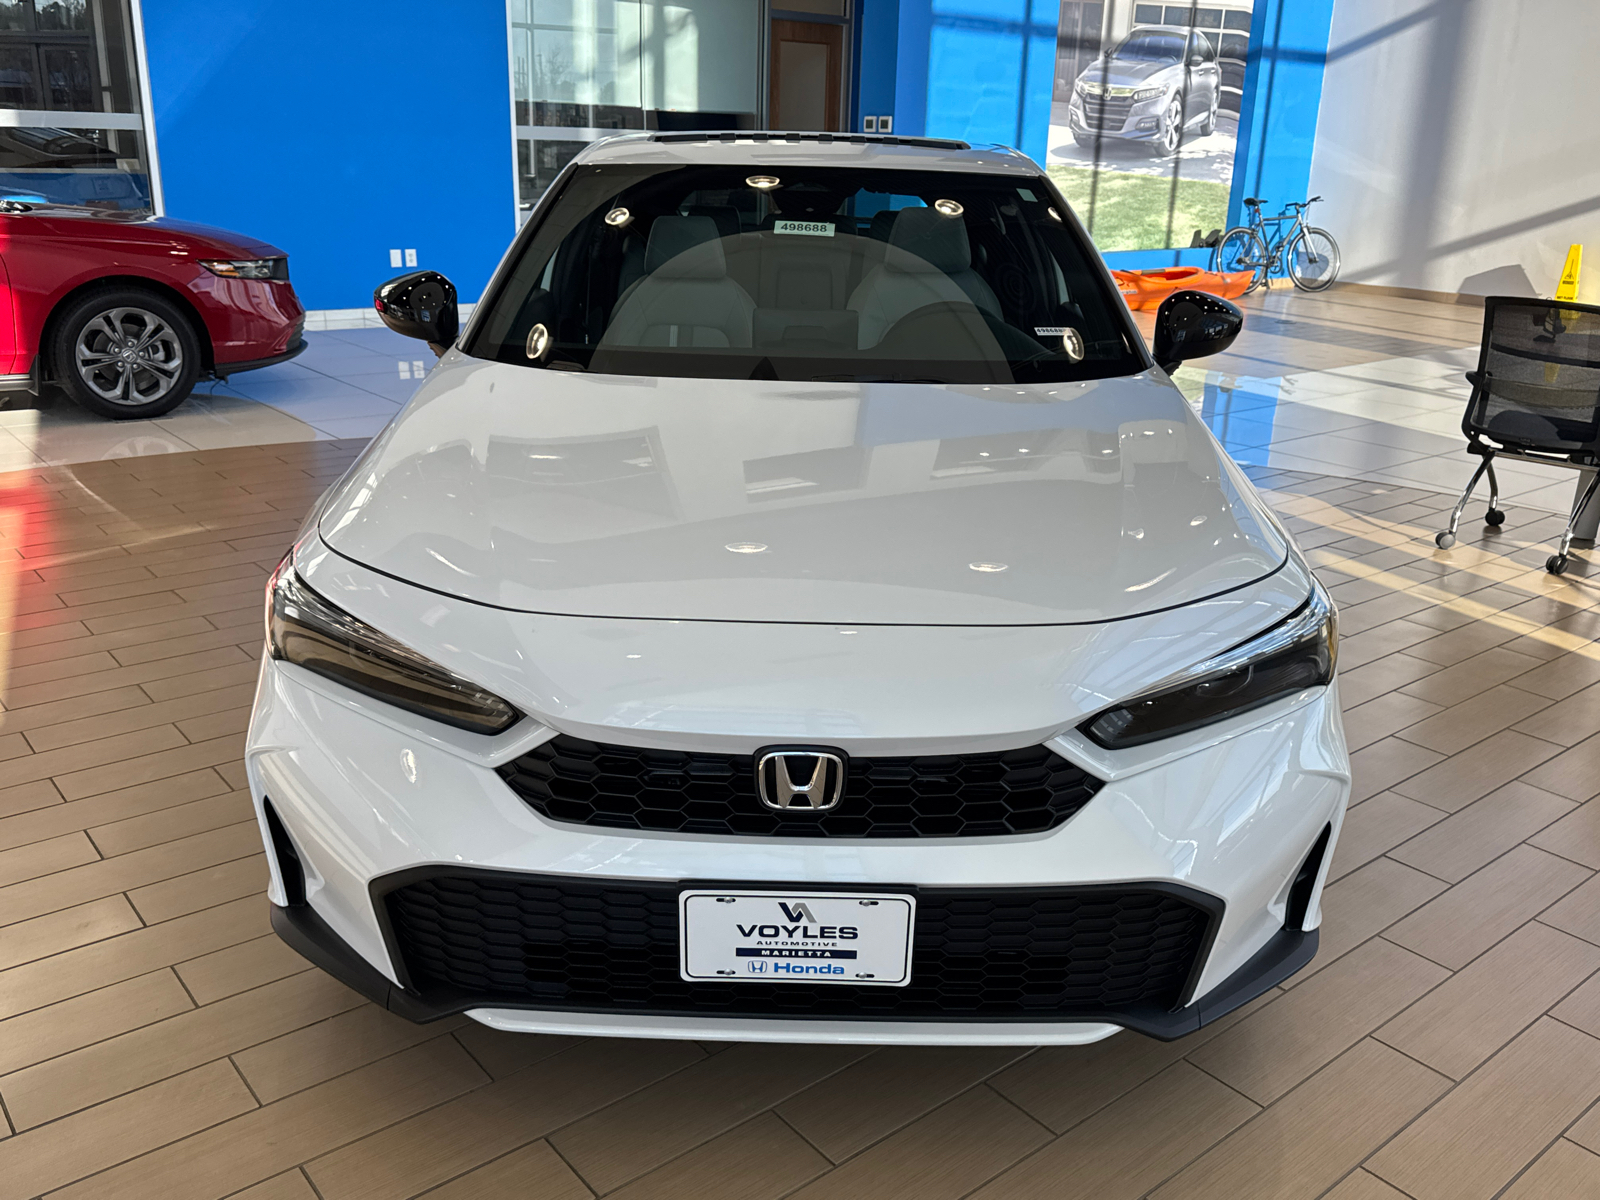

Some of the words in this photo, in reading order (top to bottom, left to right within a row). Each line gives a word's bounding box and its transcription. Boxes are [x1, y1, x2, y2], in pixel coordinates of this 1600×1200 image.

[780, 222, 827, 232] 498688
[736, 924, 858, 939] VOYLES
[761, 949, 832, 958] MARIETTA
[773, 962, 845, 975] Honda
